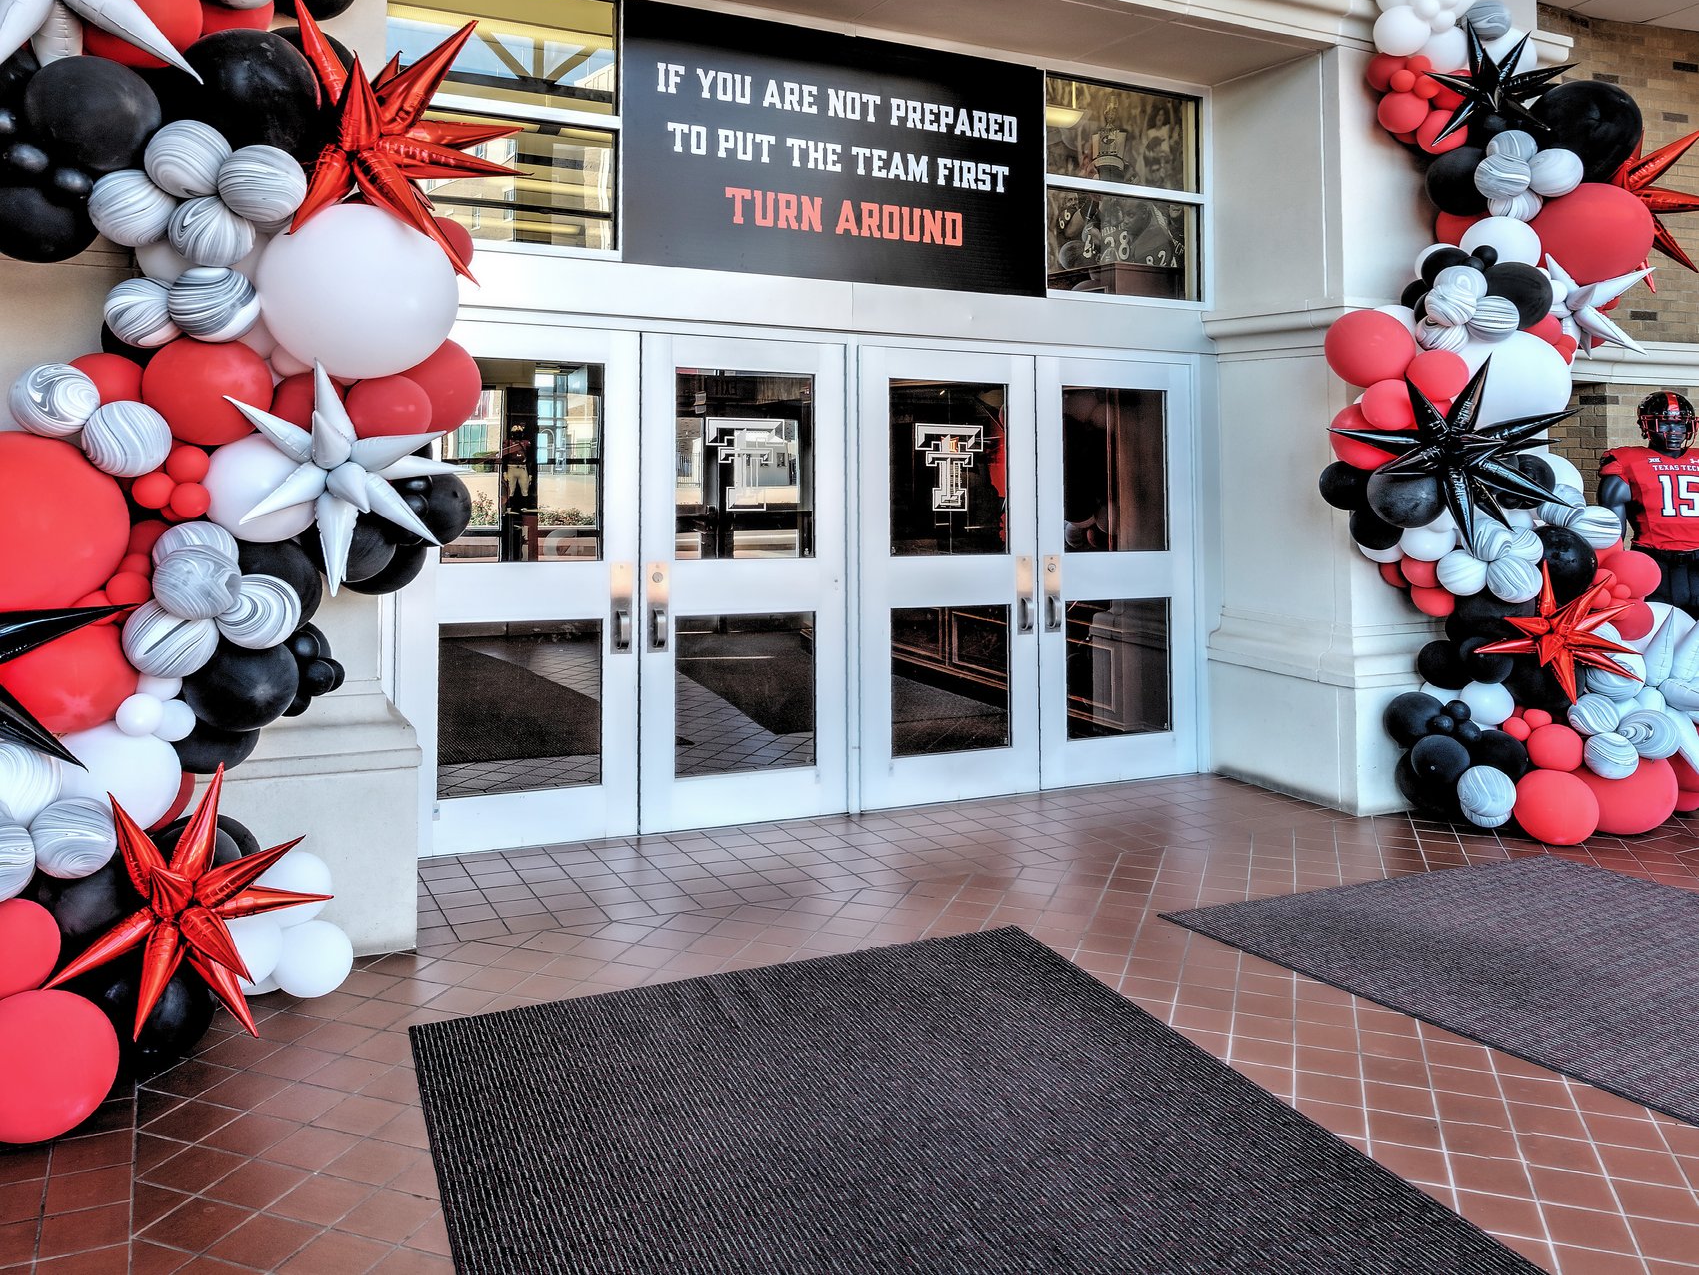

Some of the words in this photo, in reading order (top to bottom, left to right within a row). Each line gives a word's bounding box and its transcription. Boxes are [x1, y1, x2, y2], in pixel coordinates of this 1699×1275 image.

[656, 62, 685, 94] IF
[696, 68, 752, 105] YOU
[762, 79, 818, 115] ARE
[828, 88, 881, 123] NOT
[890, 97, 1018, 143] PREPARED
[667, 121, 706, 156] TO
[717, 128, 775, 164] PUT
[786, 138, 842, 173] THE
[852, 146, 928, 183] TEAM
[937, 157, 1009, 193] FIRST
[725, 187, 822, 233] TURN
[835, 200, 963, 247] AROUND
[1658, 474, 1699, 517] 15
